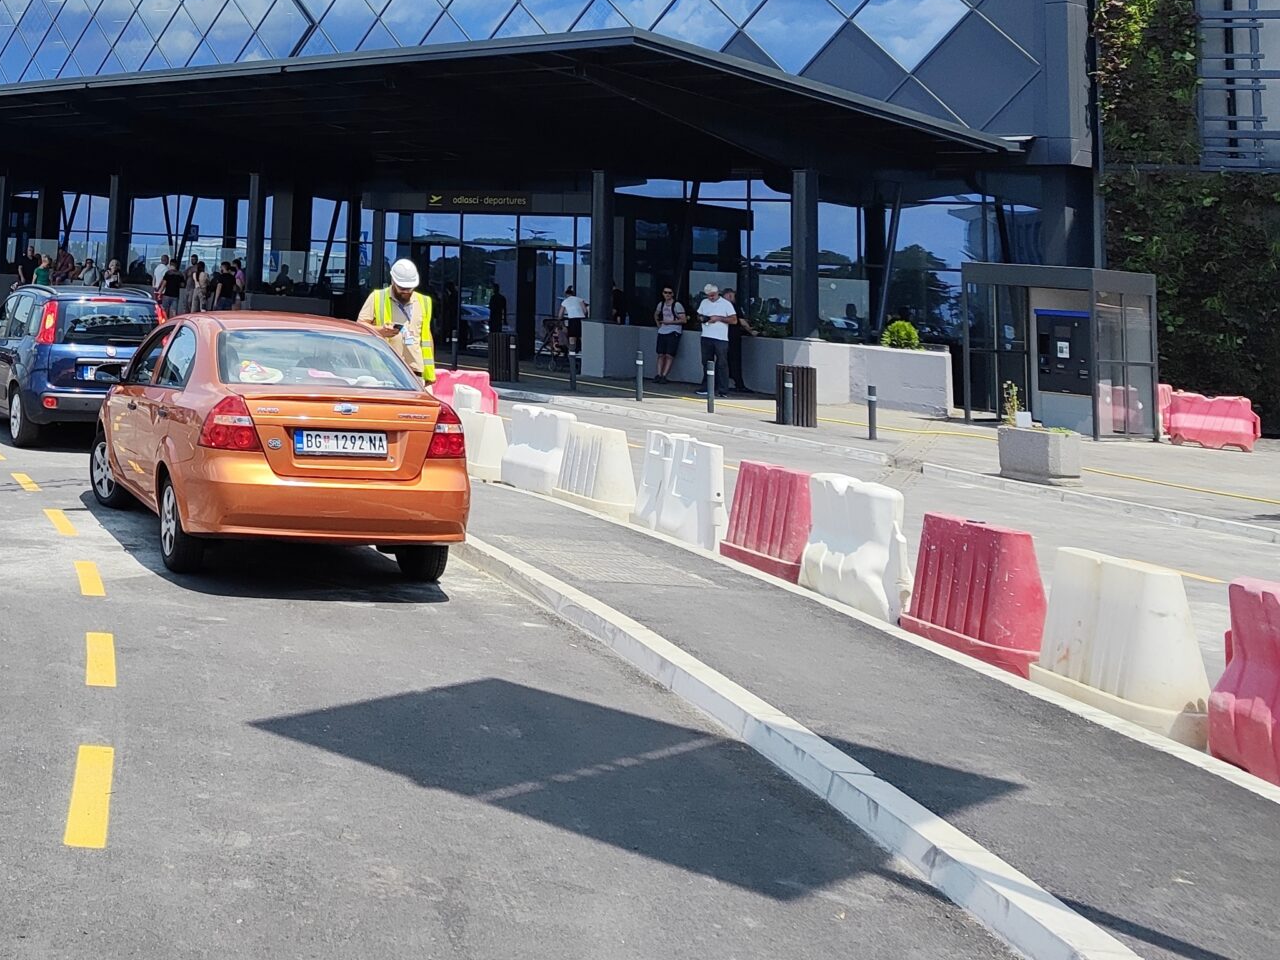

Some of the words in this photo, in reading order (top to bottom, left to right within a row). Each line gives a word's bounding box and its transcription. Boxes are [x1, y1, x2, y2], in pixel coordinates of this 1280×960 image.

[453, 196, 479, 204] odlasci
[483, 196, 527, 206] departures
[305, 433, 322, 449] BG
